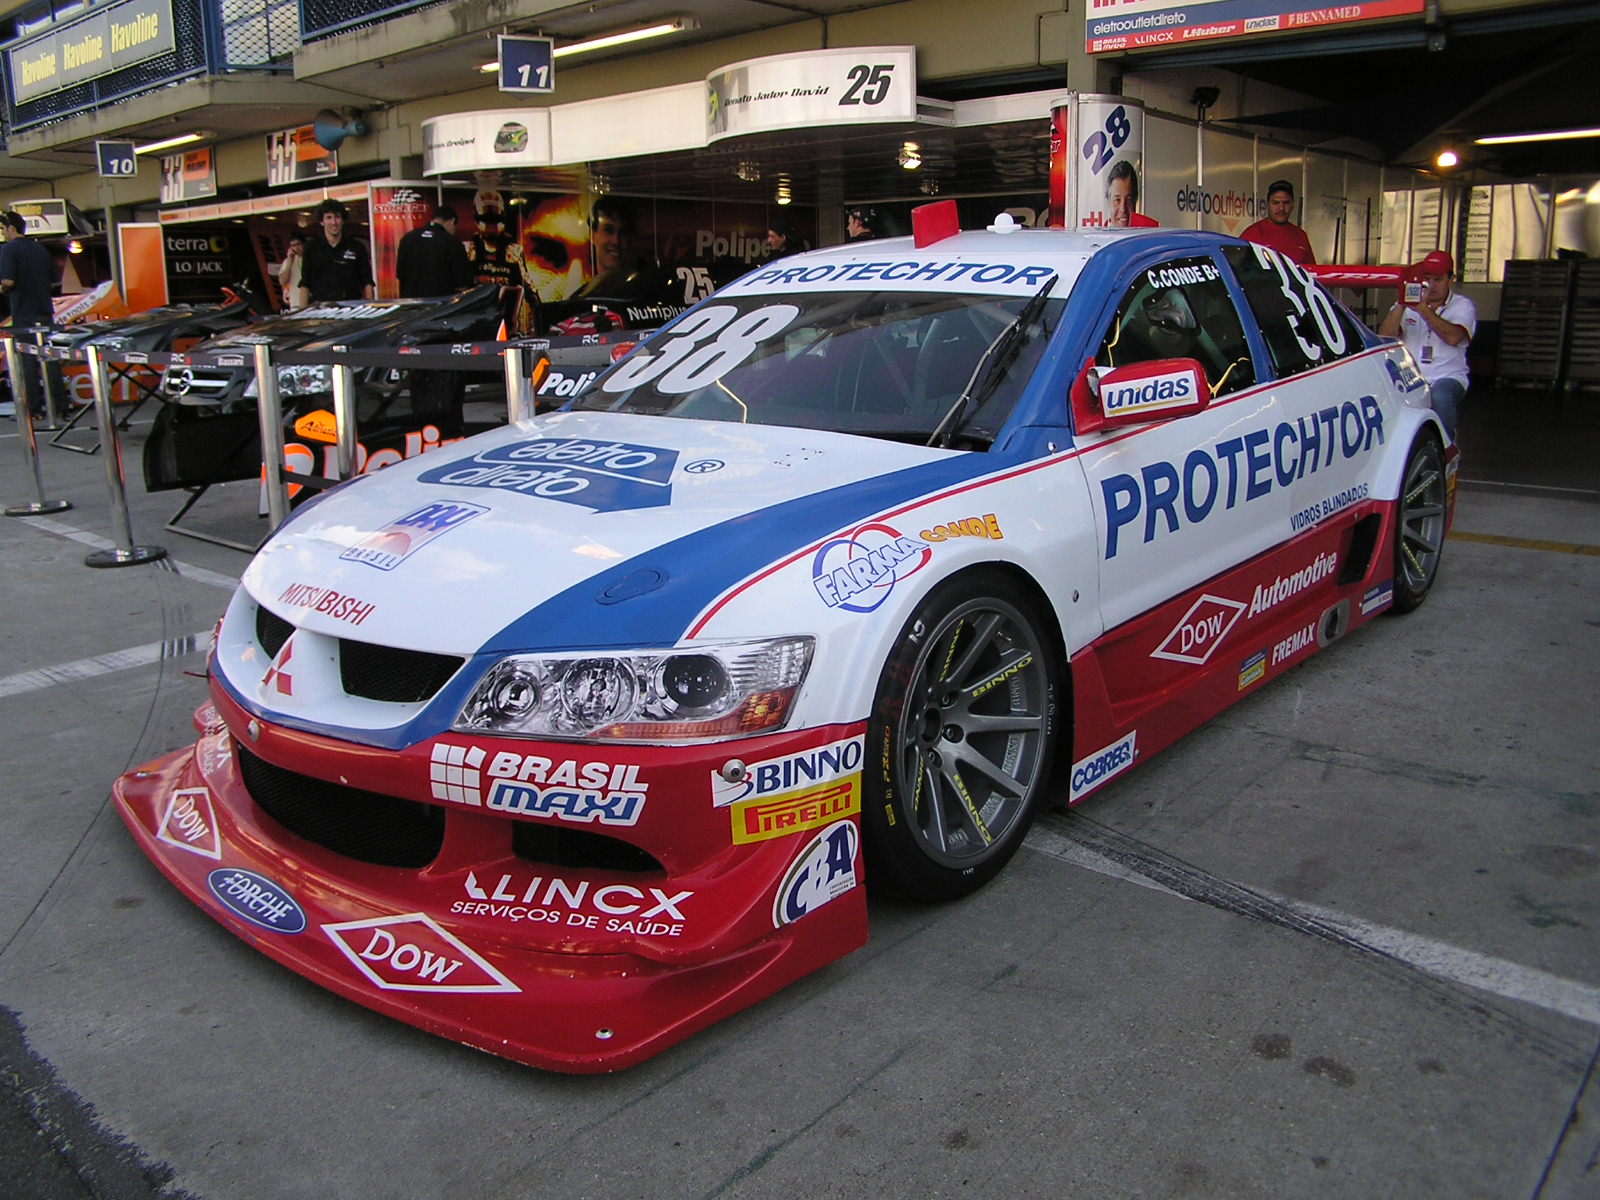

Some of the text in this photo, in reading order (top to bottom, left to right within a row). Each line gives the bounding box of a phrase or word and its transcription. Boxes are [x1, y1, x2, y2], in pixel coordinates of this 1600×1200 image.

[1296, 5, 1361, 26] BENNAMED
[22, 12, 158, 86] Havoline Havoline Havoline
[518, 64, 549, 88] 11
[838, 65, 894, 106] 25
[1082, 105, 1131, 176] 28
[109, 158, 134, 174] 10
[167, 236, 208, 251] terra
[676, 267, 715, 305] 25
[743, 261, 1054, 288] PROTECHTOR
[1250, 243, 1346, 361] 38
[602, 304, 801, 394] 38
[1107, 377, 1190, 409] unidas
[508, 440, 658, 472] eletro
[1100, 395, 1385, 560] PROTECHTOR
[439, 463, 591, 497] direto
[1290, 502, 1321, 532] VIDROS
[1322, 483, 1368, 519] BLINDADOS
[813, 513, 1003, 607] FARMA CONDE
[278, 583, 376, 626] MITSUBISHI
[1247, 551, 1337, 619] Automotive
[1180, 612, 1225, 653] DOW
[1272, 622, 1315, 666] FREMAX
[972, 657, 1033, 697] BINNO
[486, 751, 649, 793] BRASIL
[756, 740, 862, 794] BINNO
[172, 796, 209, 843] DOW
[744, 782, 852, 835] PIRELLI
[954, 774, 993, 842] BINNO
[787, 824, 852, 921] CBA
[451, 900, 683, 938] SERVIÇOS DE SAÚDE
[488, 873, 694, 921] LINCX
[359, 928, 463, 984] DOW
